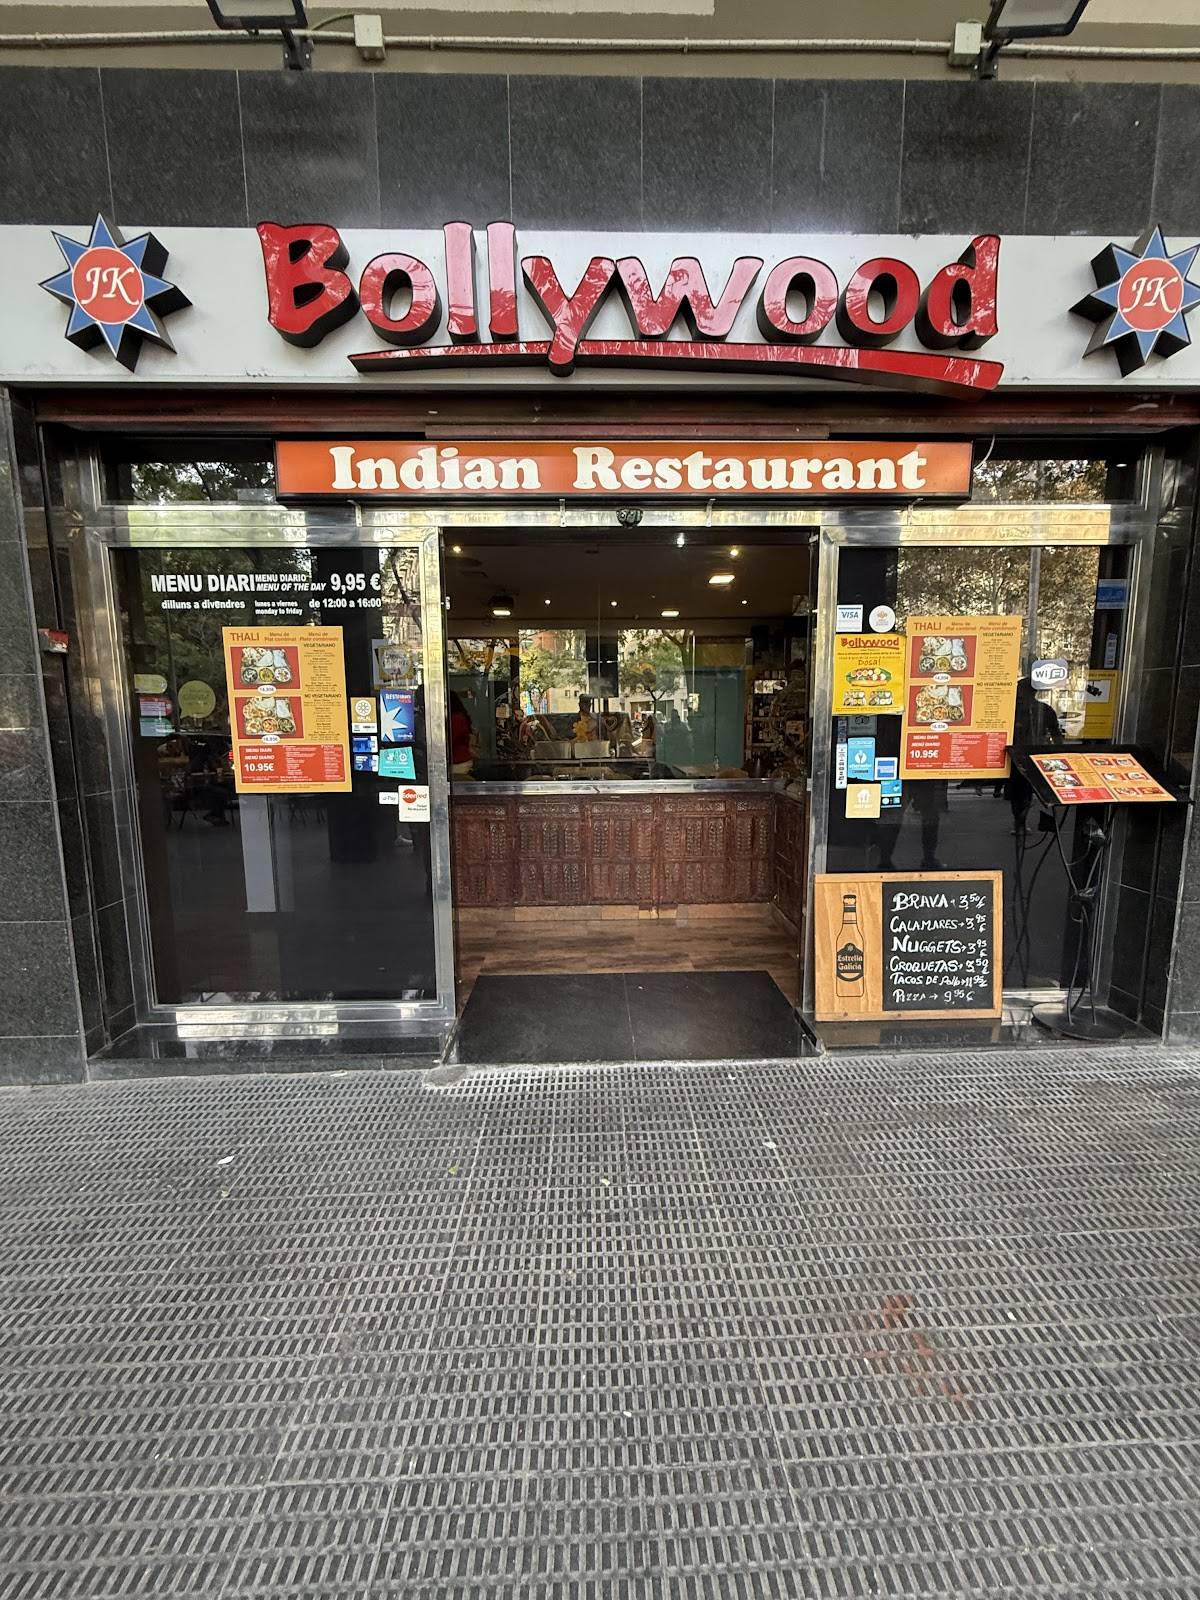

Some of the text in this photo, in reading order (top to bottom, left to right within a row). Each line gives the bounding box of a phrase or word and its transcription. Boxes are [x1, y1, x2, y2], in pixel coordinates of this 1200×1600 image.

[81, 267, 139, 305] JK
[257, 222, 1001, 372] Bollywood
[1122, 276, 1179, 313] JK
[329, 446, 927, 490] Indian Restaurant
[151, 574, 256, 592] MENU DIARI
[255, 574, 306, 582] MENU DIARIO
[256, 583, 327, 591] MENU OF THE DAY
[330, 573, 381, 595] 9,95 €
[161, 600, 192, 609] dilluns
[201, 600, 245, 609] divendres
[308, 599, 320, 608] de
[322, 599, 347, 608] 12:00
[357, 599, 381, 608] 16:00
[254, 608, 277, 616] monday
[286, 608, 303, 616] friday
[841, 611, 859, 619] VISA
[913, 622, 942, 631] THALI
[230, 632, 260, 641] THALI
[840, 637, 900, 648] Bollywood
[909, 749, 939, 759] 10.95€
[244, 763, 274, 772] 10.95€
[890, 892, 949, 912] BRAVA
[889, 915, 959, 933] CALAMARES
[890, 934, 962, 954] NUGGETS
[837, 954, 863, 962] Estrella
[837, 962, 862, 970] Galicia
[889, 955, 959, 973] CROQUETAS
[889, 972, 924, 985] TACOS
[925, 975, 939, 986] DE
